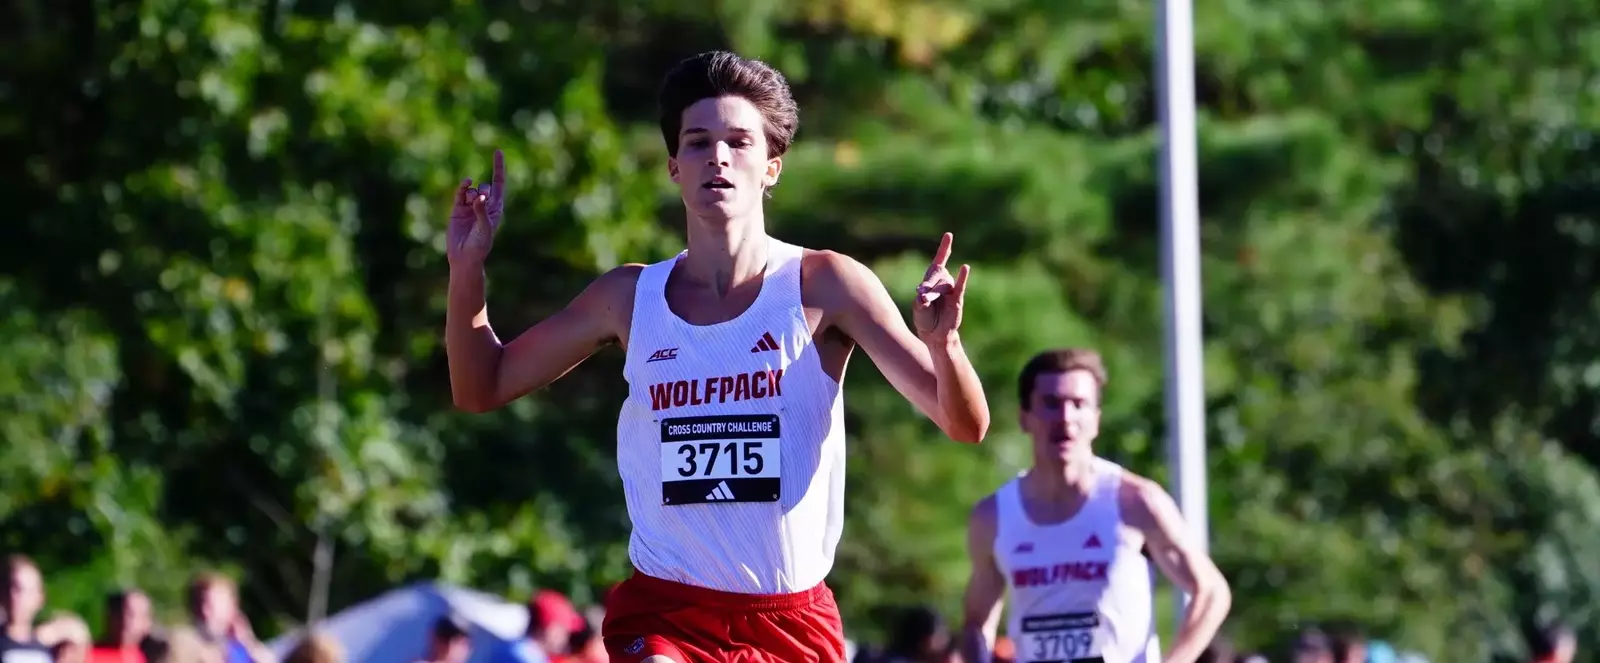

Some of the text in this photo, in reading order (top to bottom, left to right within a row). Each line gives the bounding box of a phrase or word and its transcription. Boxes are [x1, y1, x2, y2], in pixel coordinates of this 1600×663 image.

[647, 348, 679, 362] ACC
[649, 369, 783, 411] WOLFPACK
[668, 421, 773, 436] CROSS COUNTRY CHALLENGE
[677, 441, 764, 477] 3715
[1012, 561, 1108, 588] WOLFPACK
[1033, 631, 1093, 659] 3709
